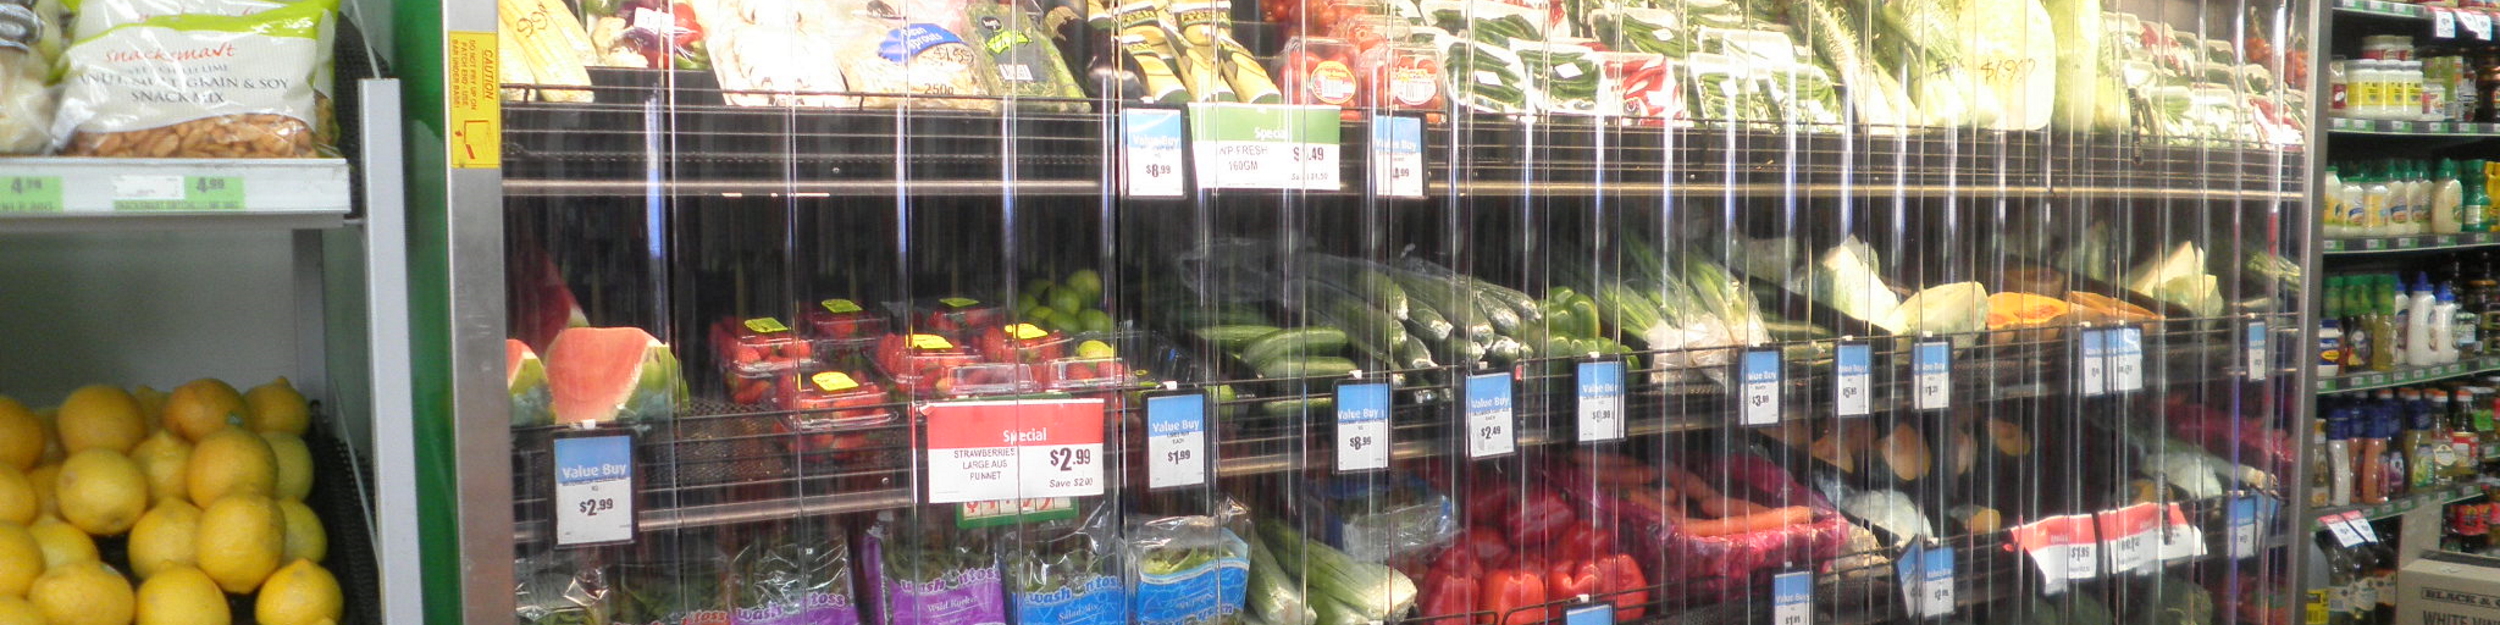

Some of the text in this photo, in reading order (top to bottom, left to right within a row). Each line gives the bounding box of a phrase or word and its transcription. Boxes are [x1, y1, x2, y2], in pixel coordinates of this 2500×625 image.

[484, 49, 494, 100] CAUTION
[1293, 146, 1325, 162] $.49
[1145, 163, 1171, 178] $8.99
[1152, 419, 1200, 433] Value Buy
[1480, 425, 1502, 440] $2.49
[1003, 427, 1047, 446] Special
[962, 458, 1008, 470] LARGE AUS
[1049, 446, 1092, 472] $2.99
[1167, 449, 1191, 465] $1.99
[561, 462, 627, 479] Value Buy
[969, 470, 1002, 481] PUNNET
[1049, 479, 1071, 488] Save
[579, 497, 614, 517] $2.99
[1028, 586, 1073, 606] wash
